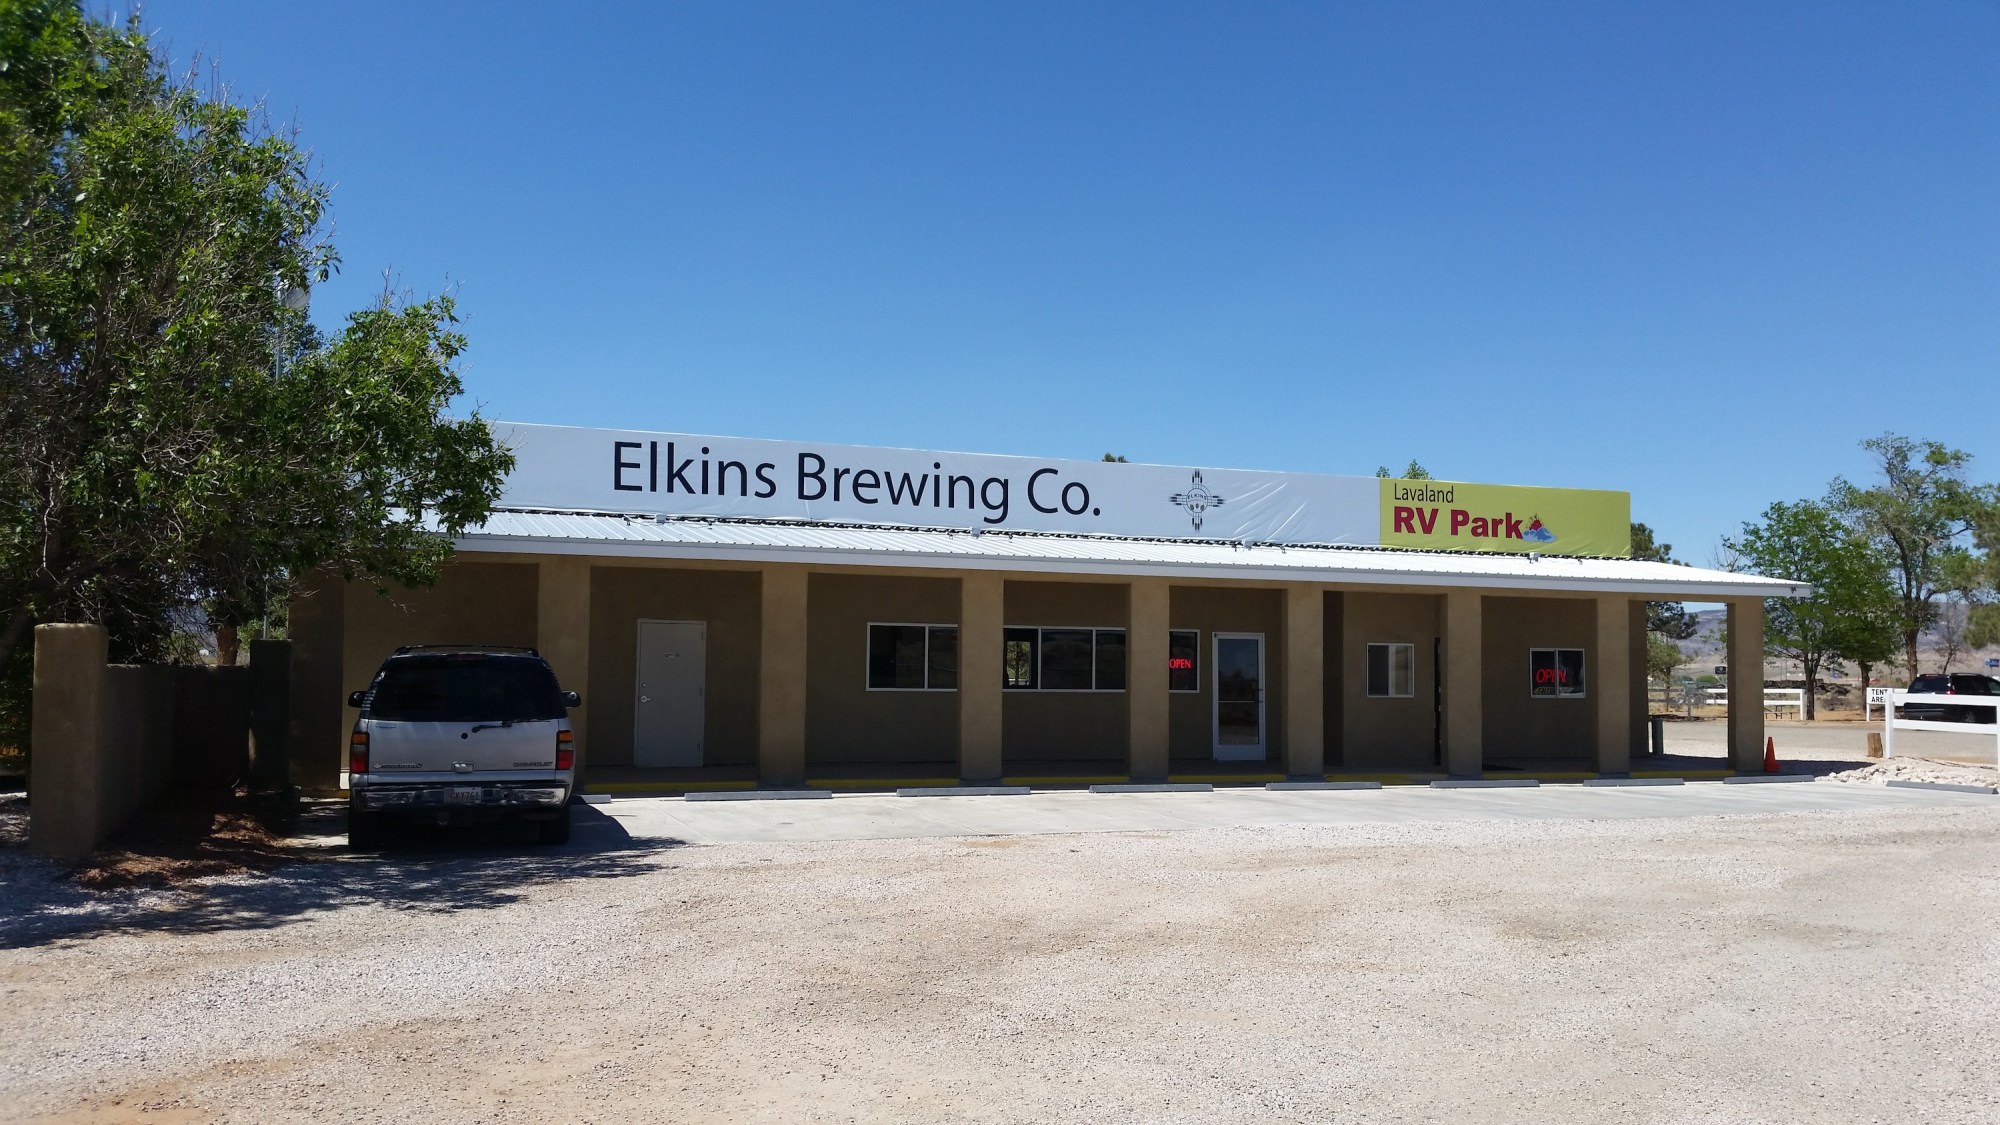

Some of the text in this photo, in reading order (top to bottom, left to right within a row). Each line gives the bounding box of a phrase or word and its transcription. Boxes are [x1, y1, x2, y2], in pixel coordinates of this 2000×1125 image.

[613, 441, 1101, 525] Elkins Brewing Co.
[1394, 483, 1454, 504] Lavaland
[1394, 506, 1524, 540] RV Park
[1169, 658, 1192, 669] OPEN
